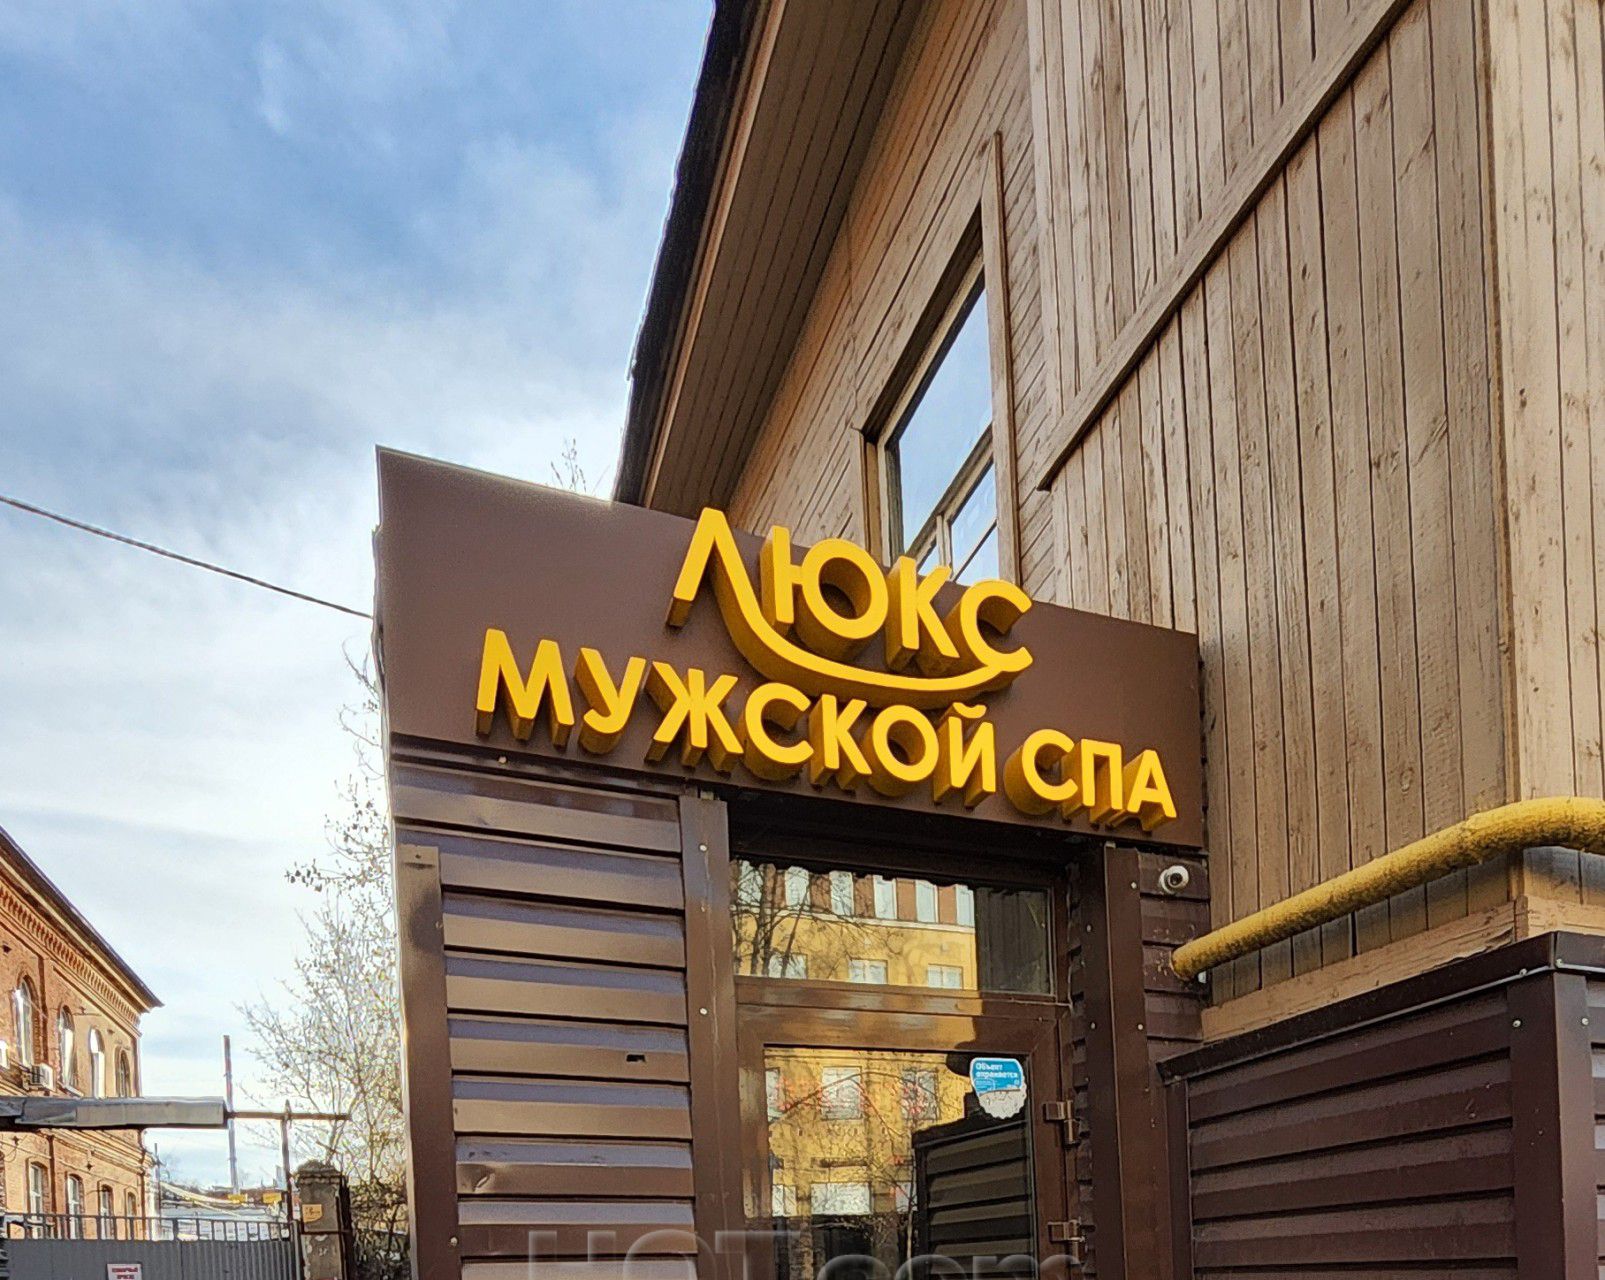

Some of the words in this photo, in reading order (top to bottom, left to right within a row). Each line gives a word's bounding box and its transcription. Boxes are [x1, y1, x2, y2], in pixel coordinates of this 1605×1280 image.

[668, 506, 1034, 696] ЛЮКС
[476, 629, 996, 804] МУЖСКОЙ
[1008, 728, 1177, 829] СПА
